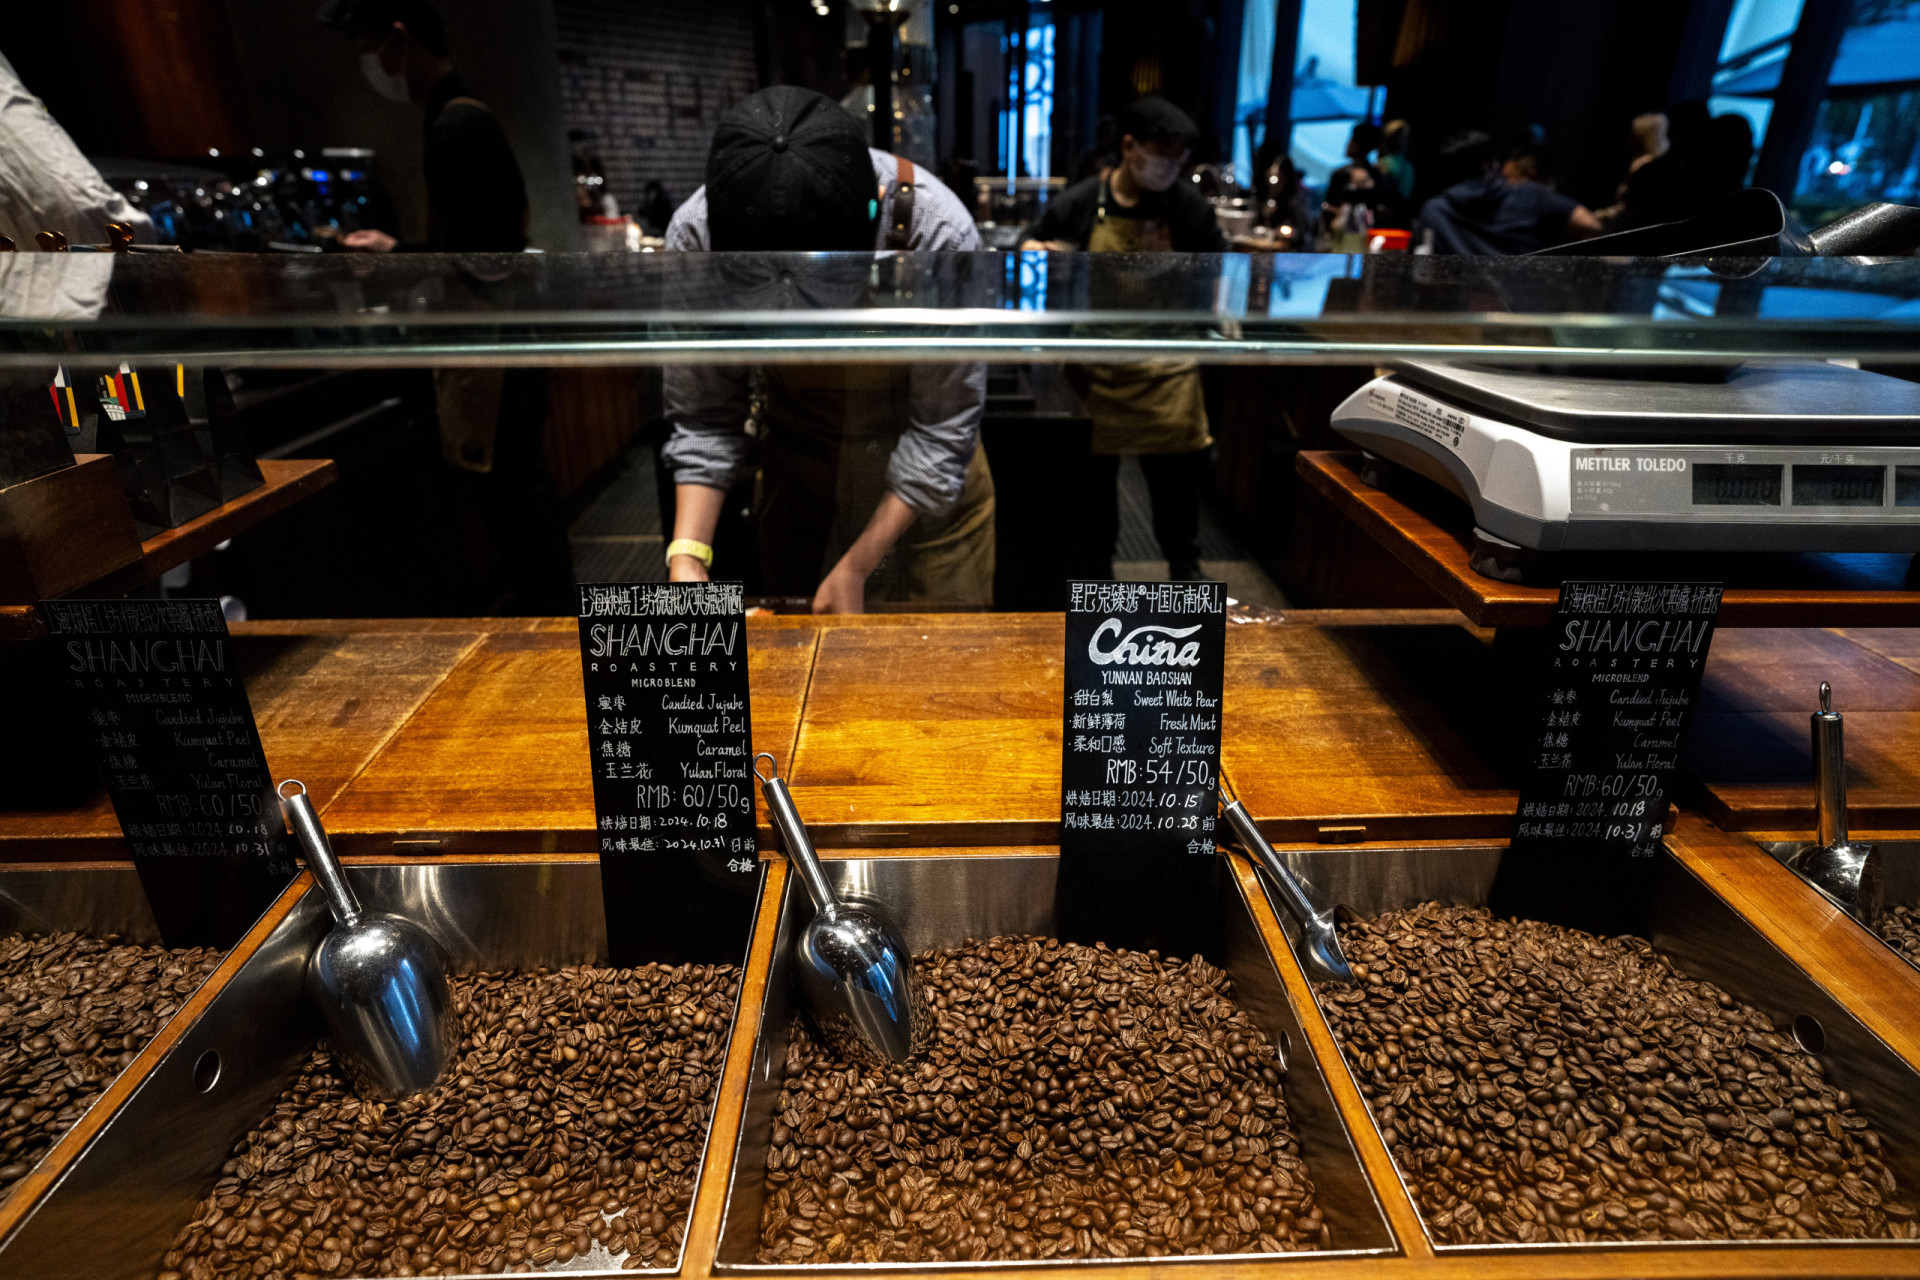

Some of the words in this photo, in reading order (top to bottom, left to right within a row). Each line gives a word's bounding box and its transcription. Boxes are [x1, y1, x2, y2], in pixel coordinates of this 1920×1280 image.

[1576, 457, 1631, 471] METTLER
[1636, 458, 1686, 472] TOLEDO
[1725, 453, 1746, 464] 千克
[1820, 454, 1855, 464] 元/千克
[590, 622, 738, 657] SHANGHAI
[1088, 617, 1202, 666] China
[1559, 620, 1708, 652] SHANGHAI
[67, 640, 224, 672] SHANGHAI
[1554, 658, 1698, 668] ROASTERY
[591, 662, 737, 672] ROASTERY
[75, 679, 233, 688] ROASTERY
[631, 678, 696, 687] MICROBLEND
[1102, 671, 1143, 685] YUNNAN
[1146, 671, 1192, 685] BAOSHAN
[1592, 673, 1649, 683] MICROBLEND
[126, 693, 192, 703] MICROBLEND
[598, 694, 626, 711] 蜜枣
[662, 694, 704, 710] Candied
[708, 693, 744, 715] Jujube
[1074, 689, 1113, 706] 甜白梨
[1134, 690, 1163, 707] Sweet
[1165, 690, 1192, 707] White
[1196, 690, 1218, 707] Pear
[1552, 689, 1578, 704] 蜜枣
[1610, 689, 1654, 705] Candied
[1656, 689, 1689, 710] Jujube
[156, 709, 206, 725] Candied
[208, 708, 245, 729] Jujube
[598, 717, 642, 734] 金桔皮
[1072, 713, 1126, 730] 新鲜薄荷
[1160, 713, 1188, 730] Fresh
[1190, 713, 1216, 731] Mint
[1547, 711, 1581, 727] 金桔皮
[1613, 711, 1656, 731] Kumquat
[1660, 711, 1682, 726] Peel
[669, 717, 718, 737] Kumquat
[722, 717, 746, 733] Peel
[174, 731, 224, 750] Kumquat
[228, 731, 251, 745] Peel
[697, 739, 747, 756] Caramel
[1074, 734, 1126, 753] 柔和口感
[1149, 736, 1172, 758] Soft
[1175, 736, 1215, 754] Texture
[1543, 732, 1569, 748] 焦糖
[1634, 733, 1679, 748] Caramel
[601, 741, 632, 757] 焦糖
[208, 752, 259, 768] Caramel
[1538, 753, 1572, 769] 玉兰花
[1616, 753, 1642, 769] Yulan
[1645, 753, 1677, 769] Floral
[606, 762, 653, 779] 玉兰花
[680, 762, 713, 779] Yulan
[714, 761, 747, 778] Floral
[1187, 838, 1216, 854] 合格
[1631, 844, 1655, 857] 合格
[727, 858, 755, 872] 合格
